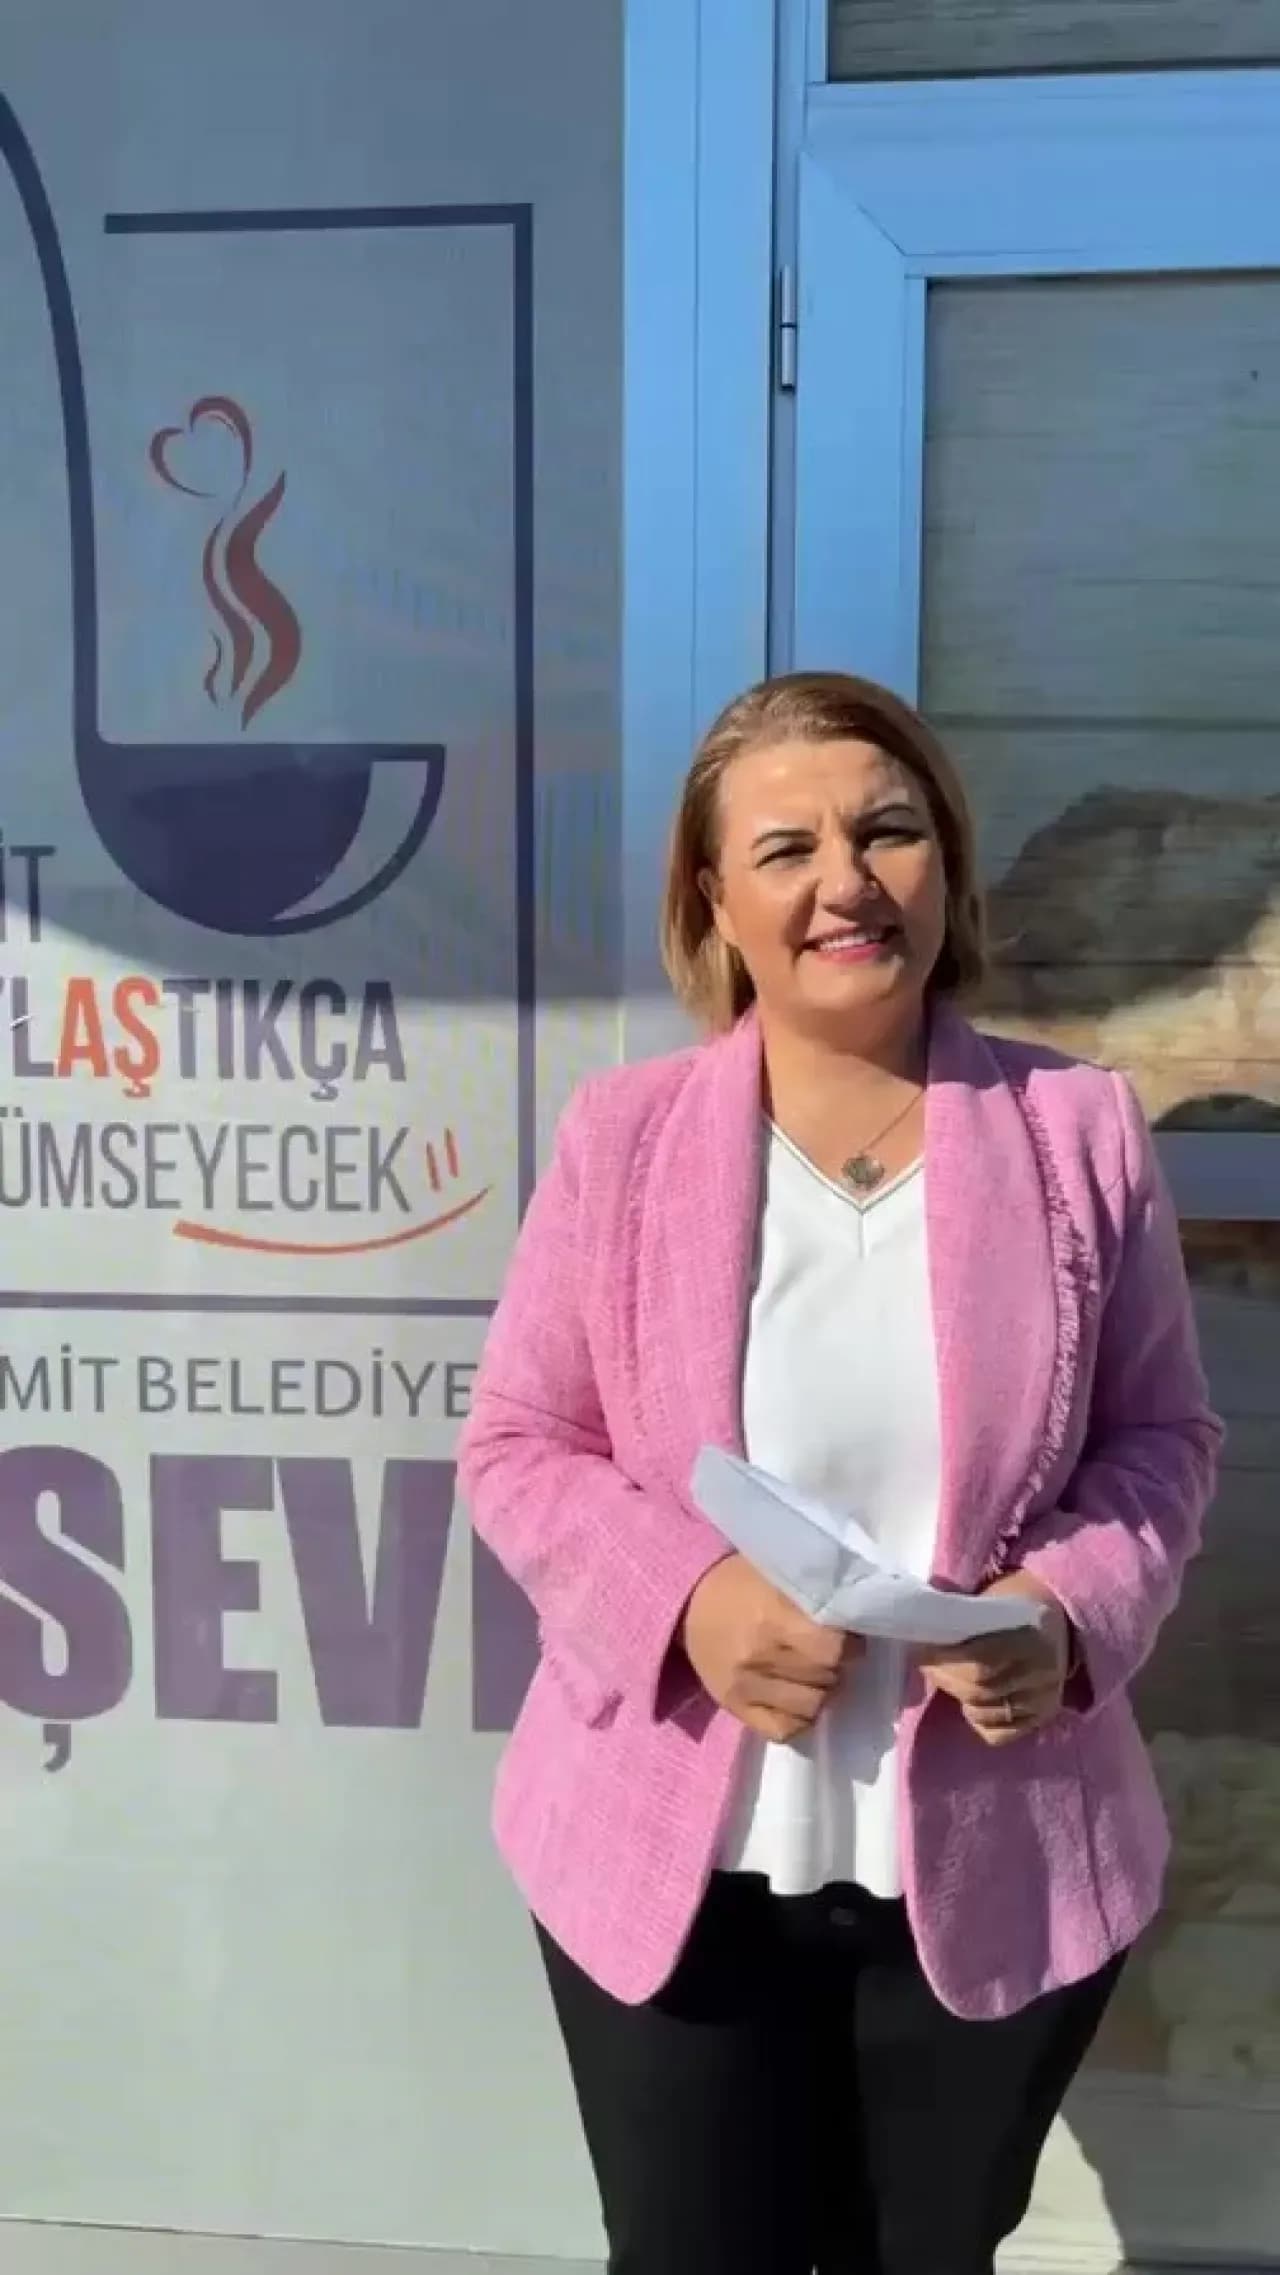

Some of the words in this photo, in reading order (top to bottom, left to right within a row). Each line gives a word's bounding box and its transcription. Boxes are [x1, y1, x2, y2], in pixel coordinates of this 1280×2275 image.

[0, 976, 407, 1101] LAŞTIKÇA
[0, 1106, 412, 1213] ÜMSEYECEK
[0, 1344, 120, 1413] MİT
[138, 1347, 478, 1418] BELEDİYE
